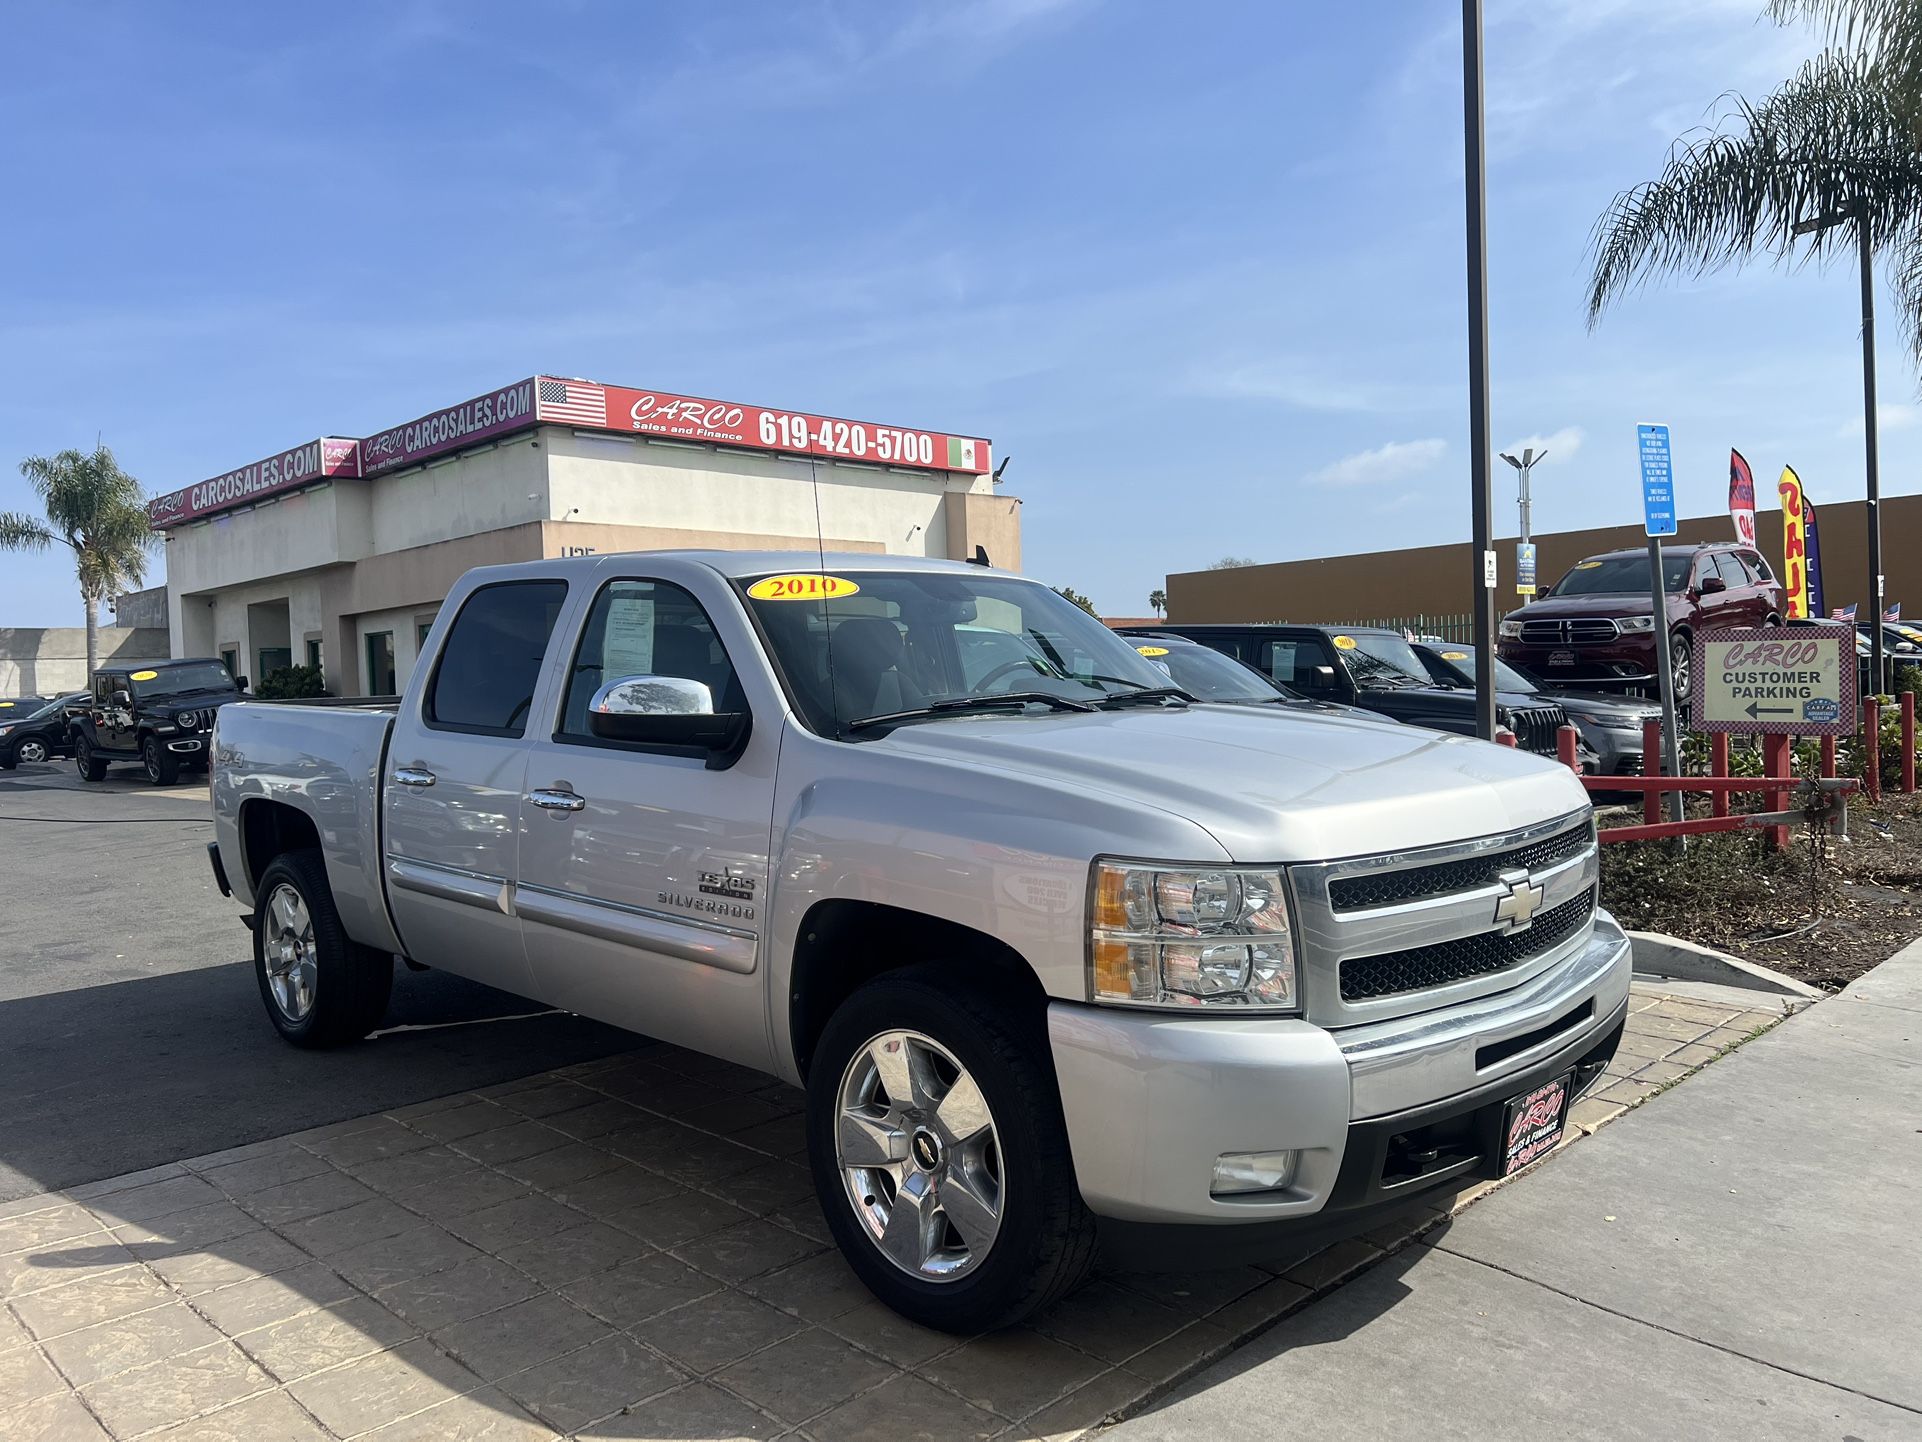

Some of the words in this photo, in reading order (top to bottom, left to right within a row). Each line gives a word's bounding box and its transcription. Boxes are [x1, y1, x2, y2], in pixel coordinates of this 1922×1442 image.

[405, 383, 530, 453] CARCOSALES.COM
[630, 395, 744, 429] CARCO
[365, 430, 404, 462] CARCO
[632, 421, 667, 432] Sales
[671, 426, 693, 435] and
[697, 428, 743, 441] Finance
[759, 411, 933, 464] 619-420-5700
[191, 444, 318, 511] CARCOSALES.COM
[151, 491, 184, 519] CARCO
[770, 578, 837, 597] 2010
[1723, 641, 1818, 670] CARCO
[1722, 671, 1821, 684] CUSTOMER
[1732, 686, 1811, 699] PARKING
[658, 891, 754, 920] SILVERADO
[1508, 1089, 1564, 1148] CARCO
[1507, 1138, 1526, 1159] SALES
[1530, 1119, 1559, 1142] FINANCE
